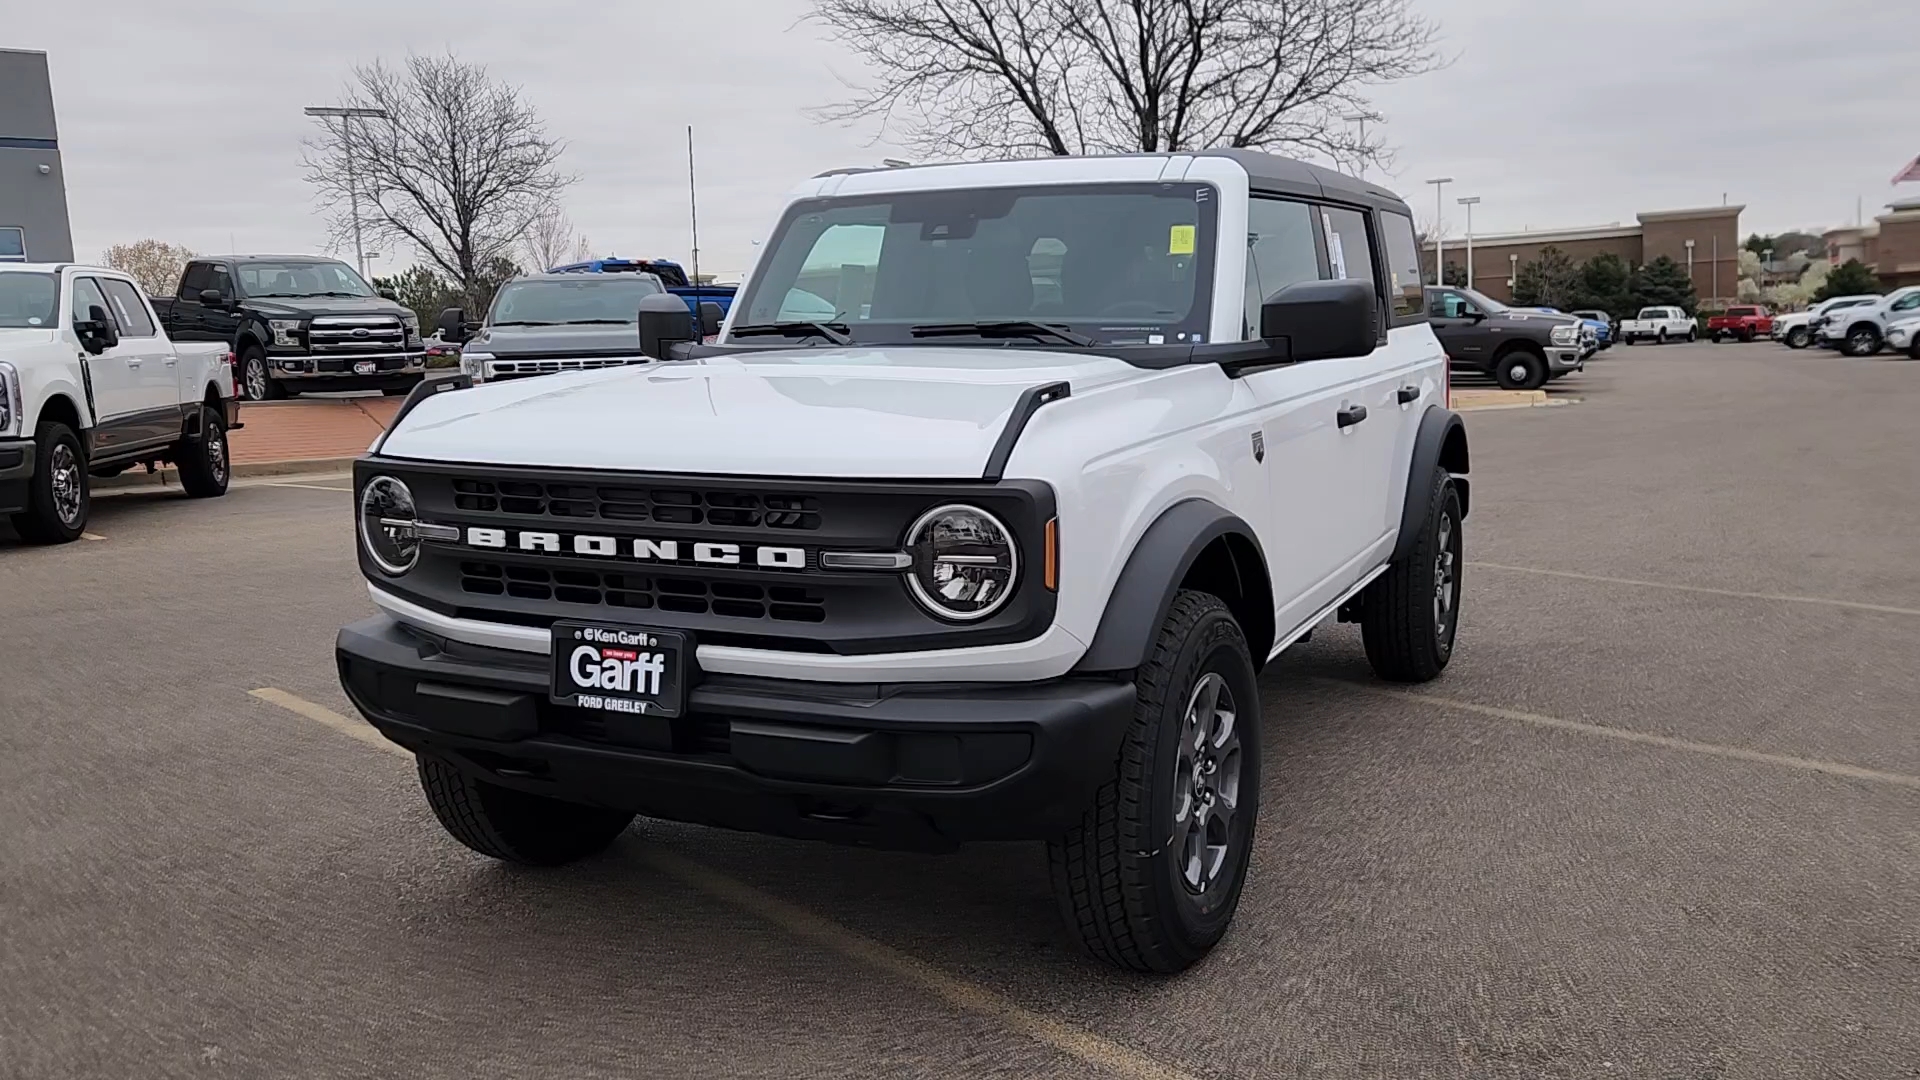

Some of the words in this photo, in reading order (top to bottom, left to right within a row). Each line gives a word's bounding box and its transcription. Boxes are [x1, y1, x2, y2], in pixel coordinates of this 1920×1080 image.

[467, 527, 805, 568] BRONCO
[594, 628, 618, 643] Ken
[618, 631, 648, 647] Garff
[569, 645, 665, 695] Garff
[578, 695, 603, 709] FORD
[604, 698, 647, 714] GREELEY
